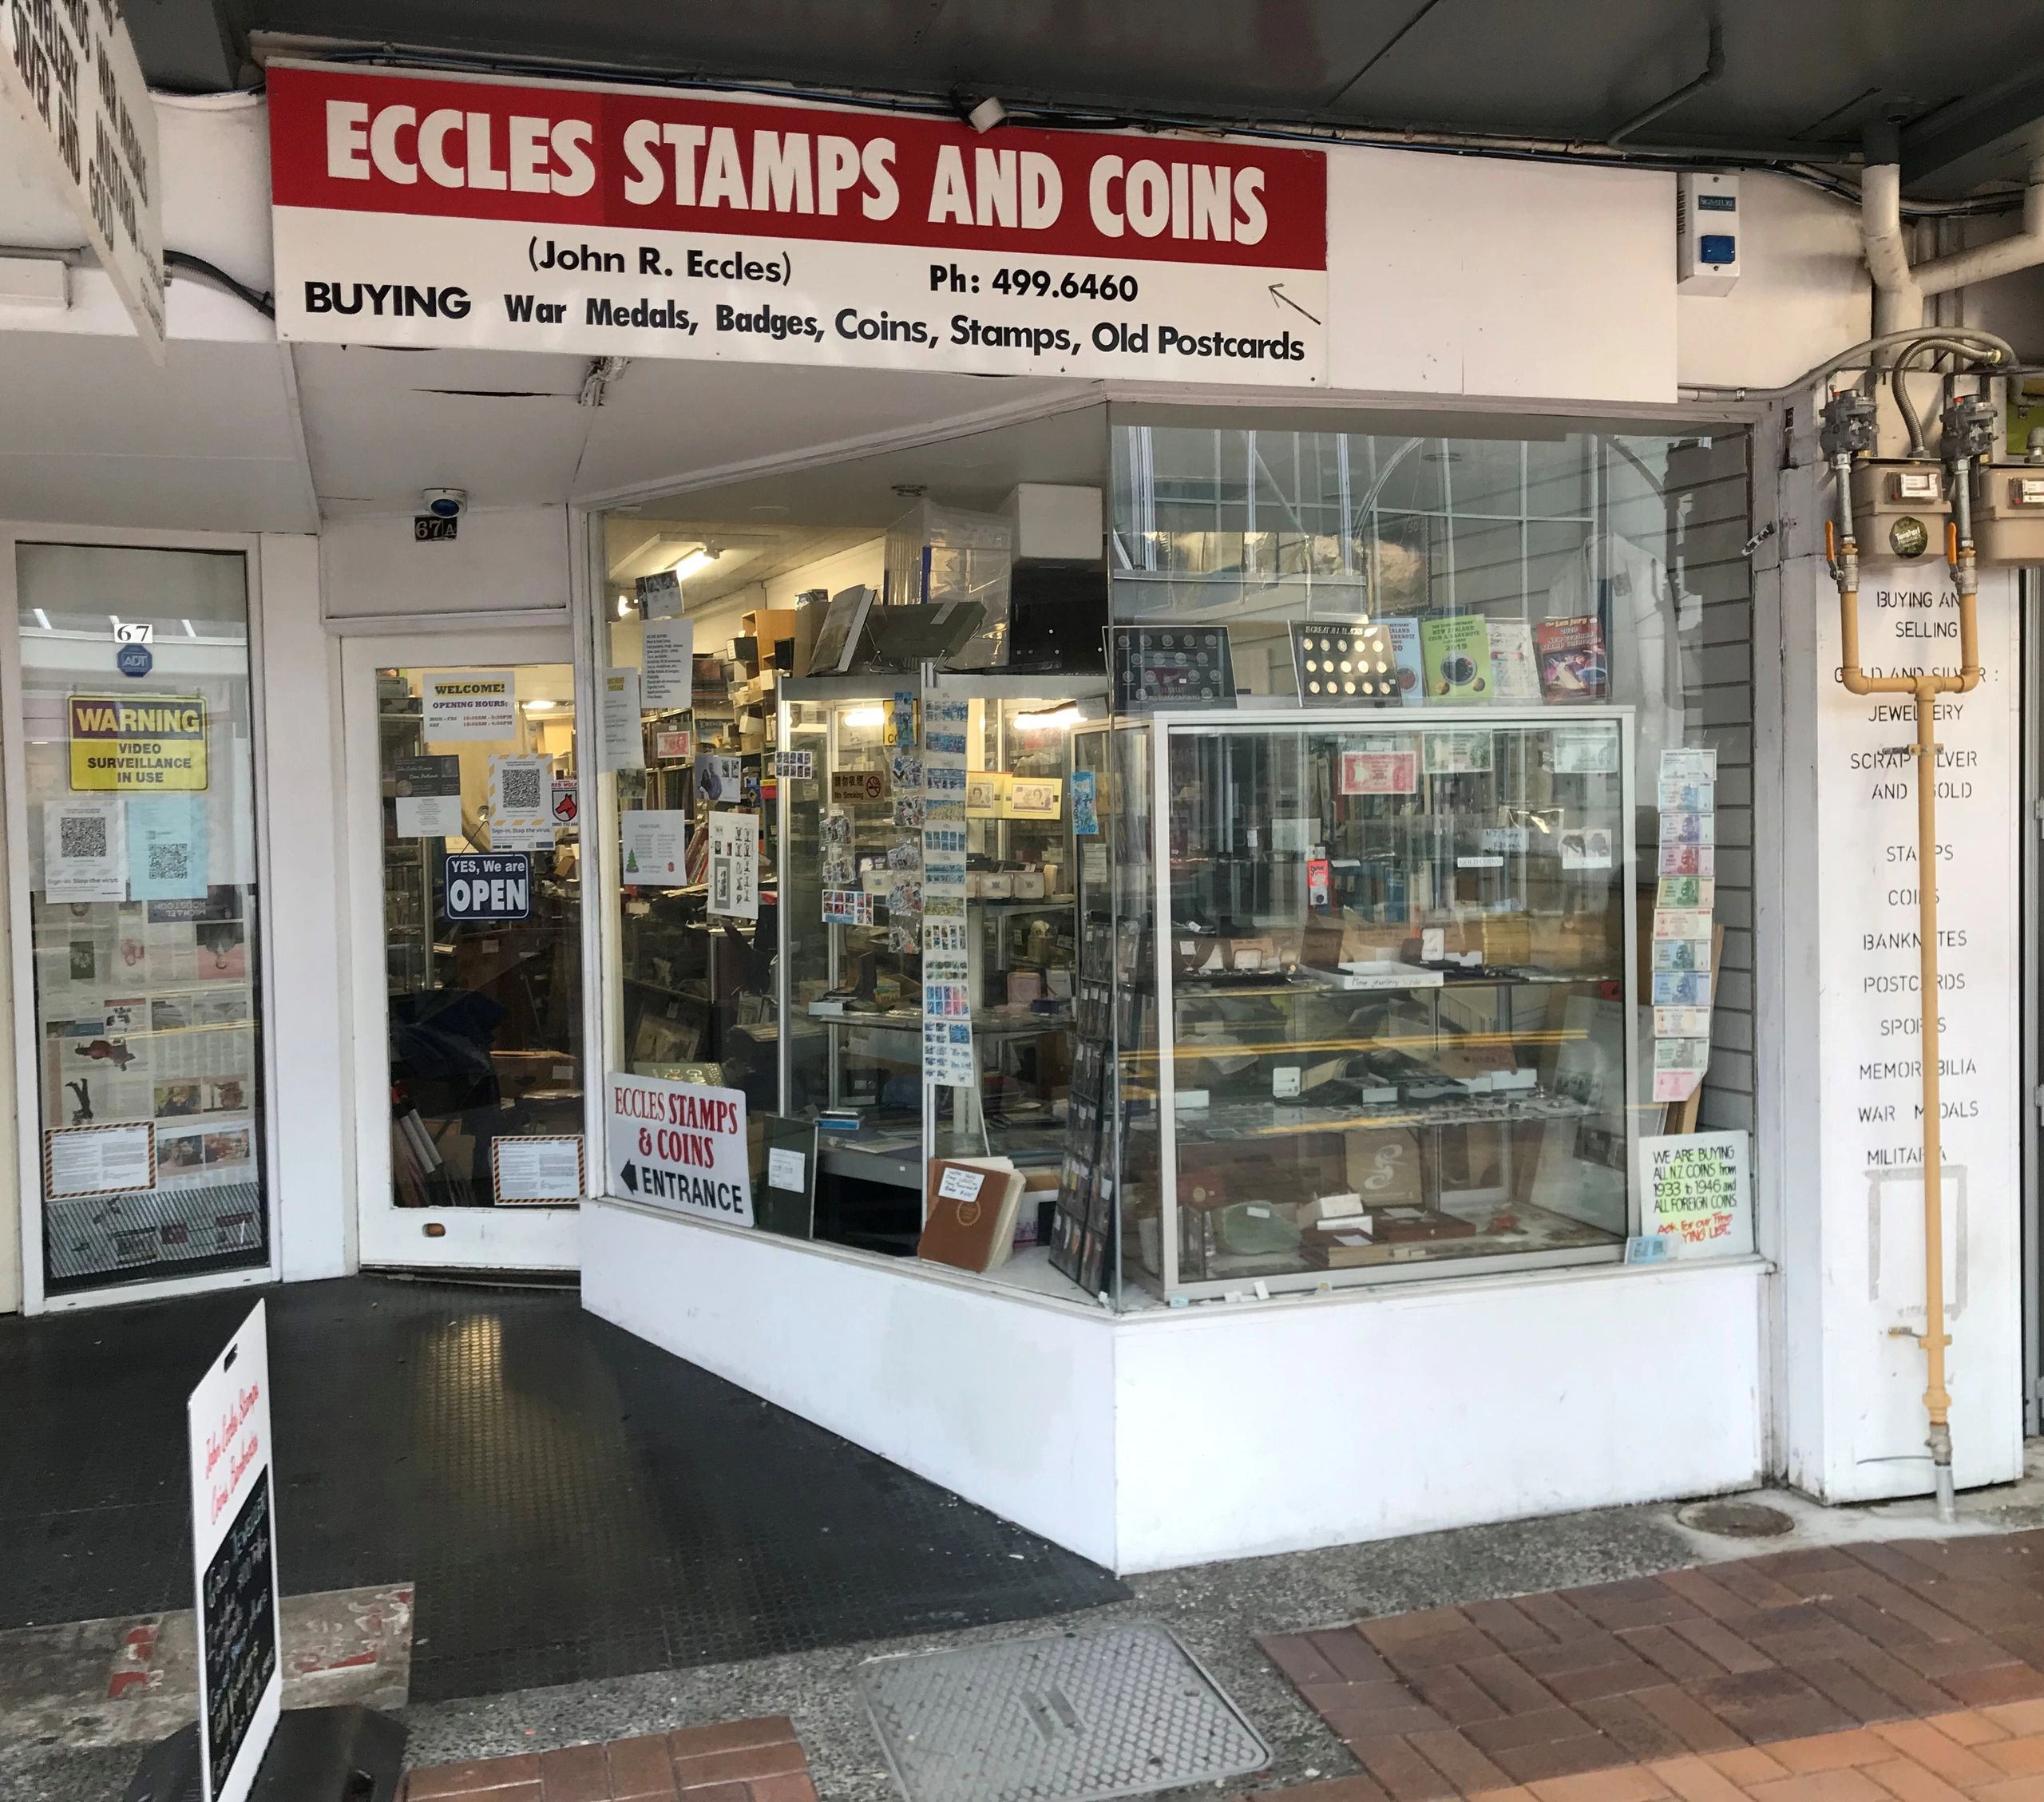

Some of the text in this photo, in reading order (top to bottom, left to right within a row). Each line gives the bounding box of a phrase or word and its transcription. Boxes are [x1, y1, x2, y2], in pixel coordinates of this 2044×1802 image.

[326, 99, 1268, 246] ECCLES STAMPS AND COINS
[529, 236, 792, 287] (John R. Eccles)
[929, 264, 1139, 303] Ph: 499.6460
[304, 280, 1305, 361] BUYING War Medals, Badges, Coins, Stamps, Old Postcards
[1876, 591, 1961, 608] BUYING AN
[117, 624, 152, 642] 67
[1895, 621, 1958, 638] SELLING
[123, 655, 148, 667] ADT
[1834, 667, 1882, 683] GLD
[1932, 666, 1986, 683] SILR
[434, 683, 505, 695] WELCOME!
[76, 708, 200, 733] WARNING
[1868, 704, 1964, 722] JEWELERY
[118, 743, 162, 755] VIDEO
[87, 757, 192, 770] SURVEILLANCE
[1851, 751, 1911, 770] SCRAP
[117, 771, 164, 784] IN USE
[1872, 782, 1907, 800] AND
[1887, 845, 1954, 862] STAPS
[451, 860, 525, 875] YES, We are
[450, 878, 527, 912] OPEN
[1888, 888, 1939, 905] COI
[1863, 929, 1967, 950] BANKNTES
[1864, 973, 1966, 993] POSTCRDS
[1880, 1017, 1947, 1036] SPOS
[1860, 1058, 1977, 1079] MEMORBILIA
[614, 1087, 738, 1135] ECCLES STAMPS
[1859, 1100, 1979, 1123] WAR MDALS
[639, 1127, 715, 1169] & COINS
[1653, 1145, 1735, 1165] WE ARE BUYING
[1868, 1146, 1947, 1166] MILITAA
[1654, 1165, 1668, 1181] ALL
[1686, 1163, 1717, 1178] COINS
[641, 1166, 744, 1214] ENTRANCE
[1654, 1178, 1737, 1198] 1933 to 1946 and
[1654, 1198, 1670, 1214] ALL
[1670, 1197, 1709, 1212] FOREIGN
